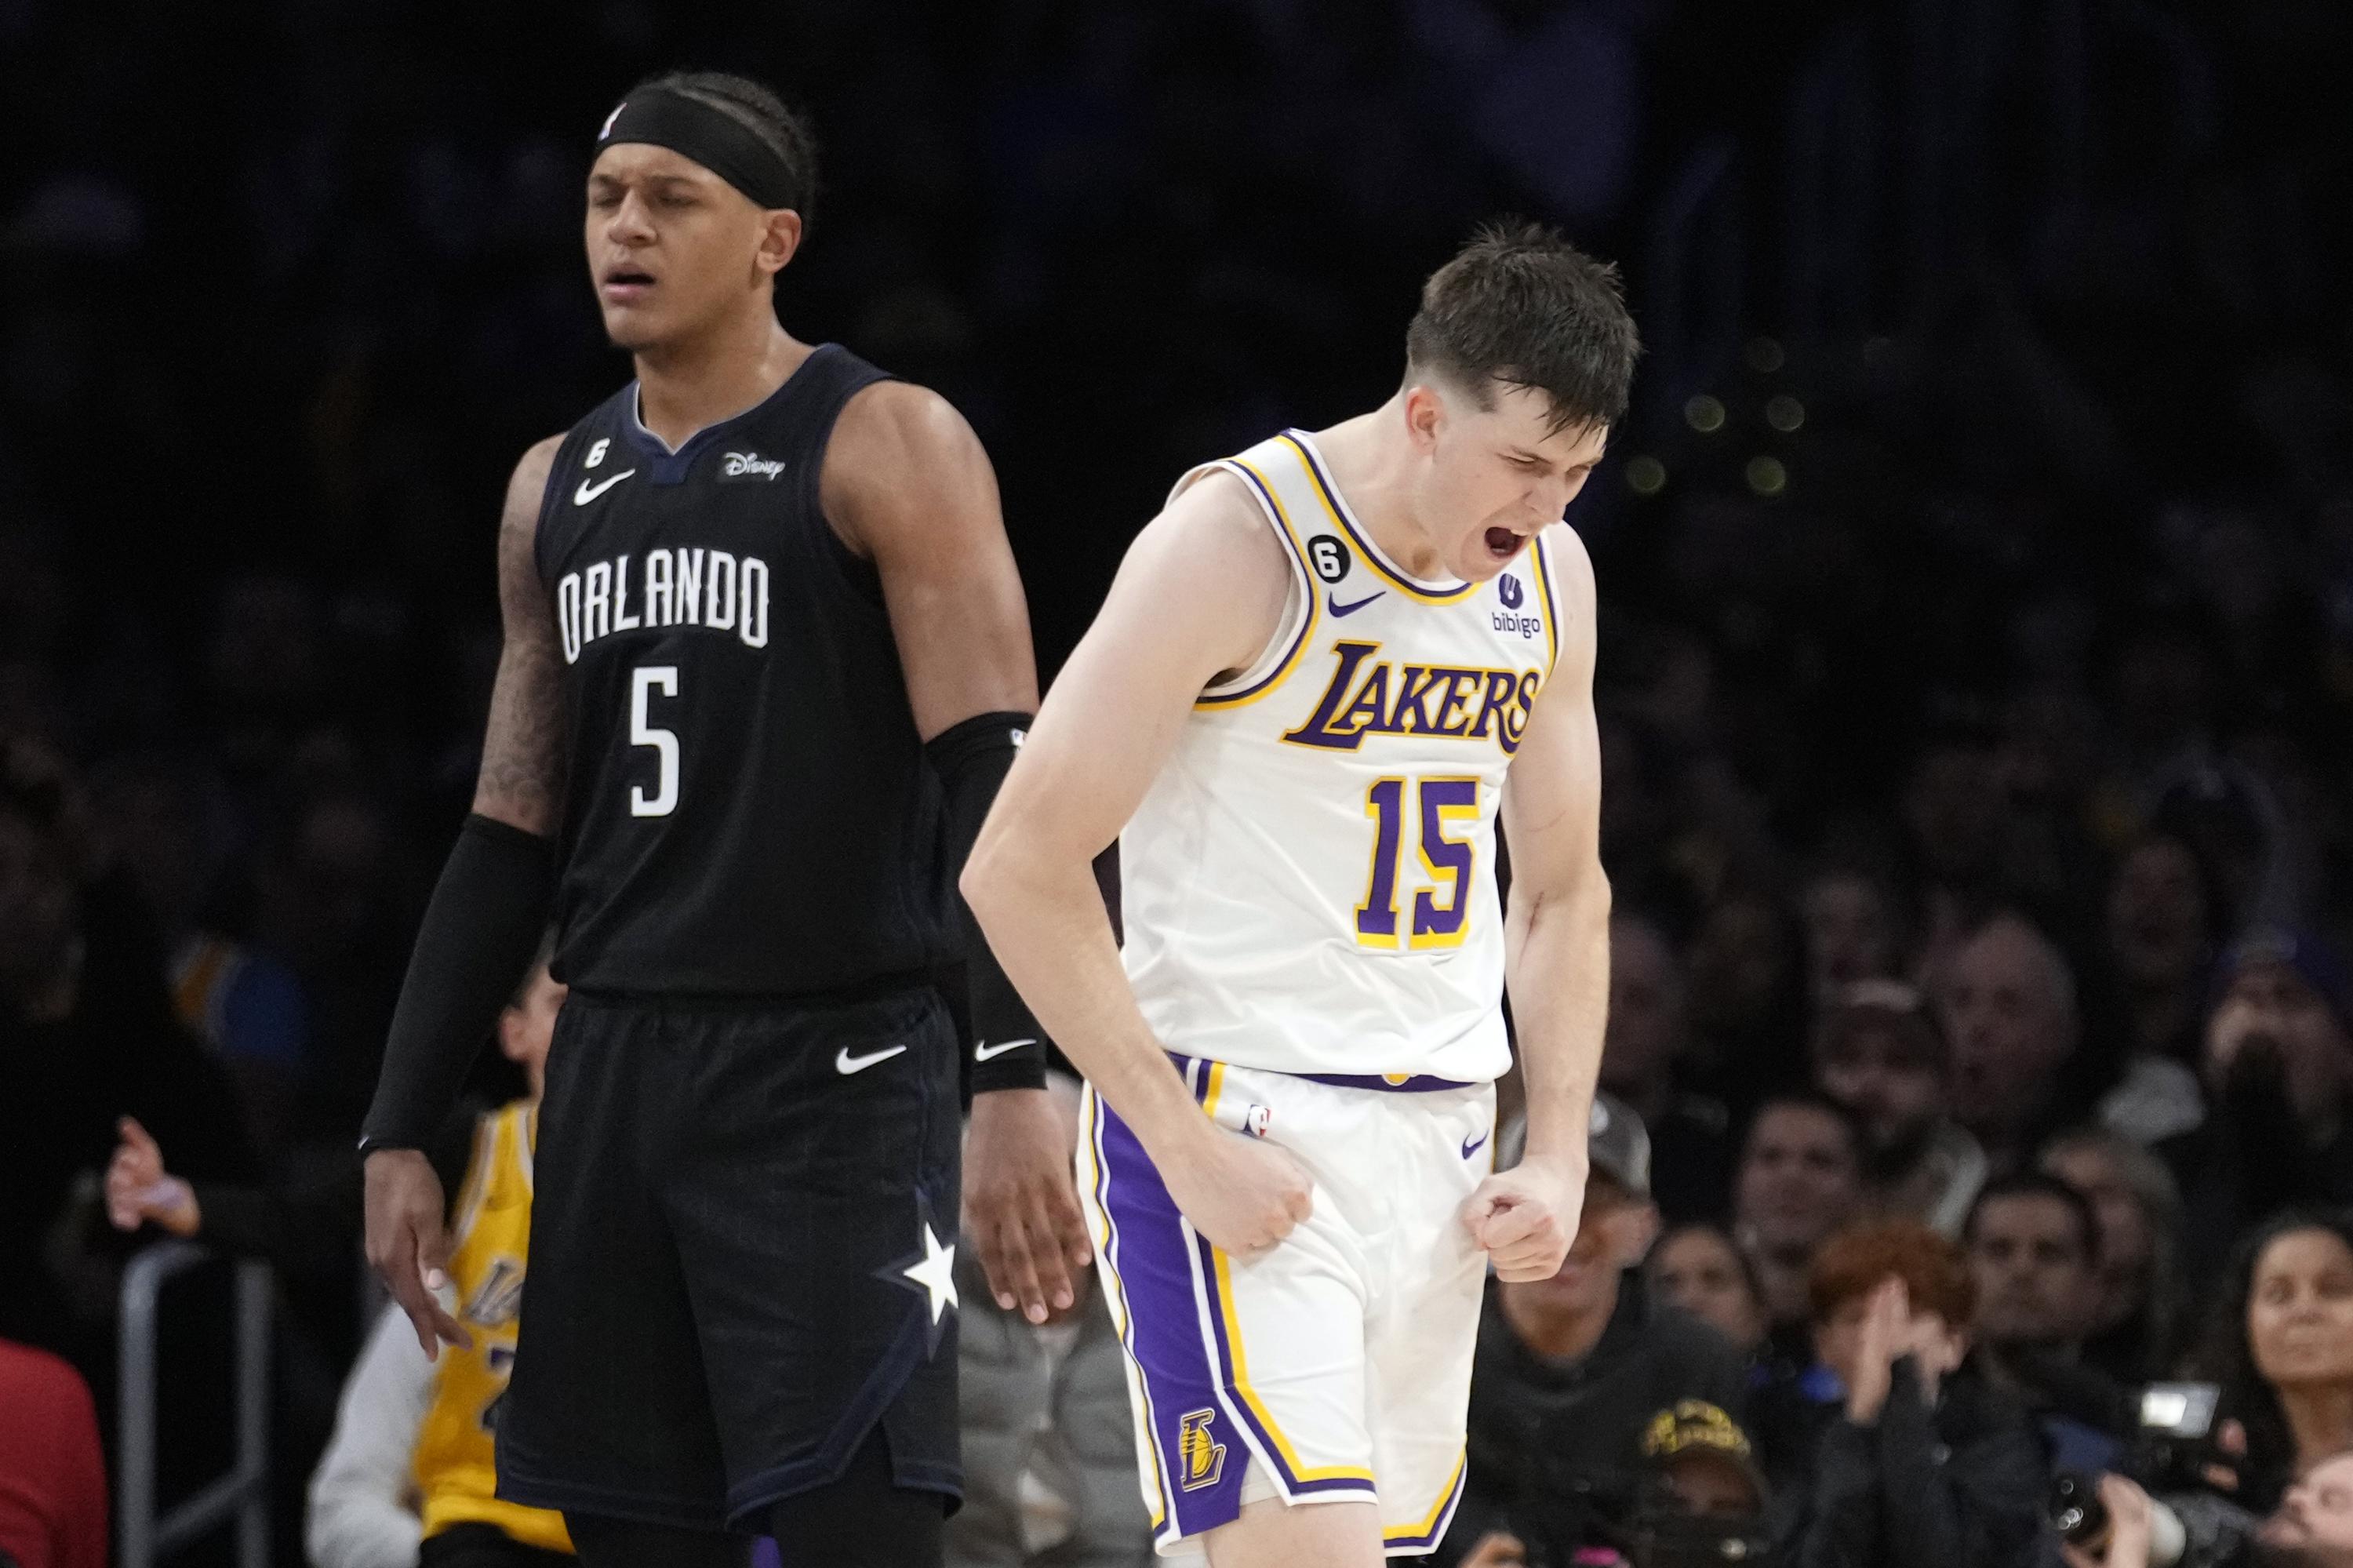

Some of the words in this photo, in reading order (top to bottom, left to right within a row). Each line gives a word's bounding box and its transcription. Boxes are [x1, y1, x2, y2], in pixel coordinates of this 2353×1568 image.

[585, 438, 610, 468] 6
[723, 452, 786, 481] Disney
[1315, 541, 1342, 579] 6
[558, 548, 769, 665] ORLANDO
[1491, 612, 1540, 639] bibigo
[1280, 640, 1540, 758] LAKERS
[631, 666, 681, 818] 5
[1354, 776, 1481, 951] 15
